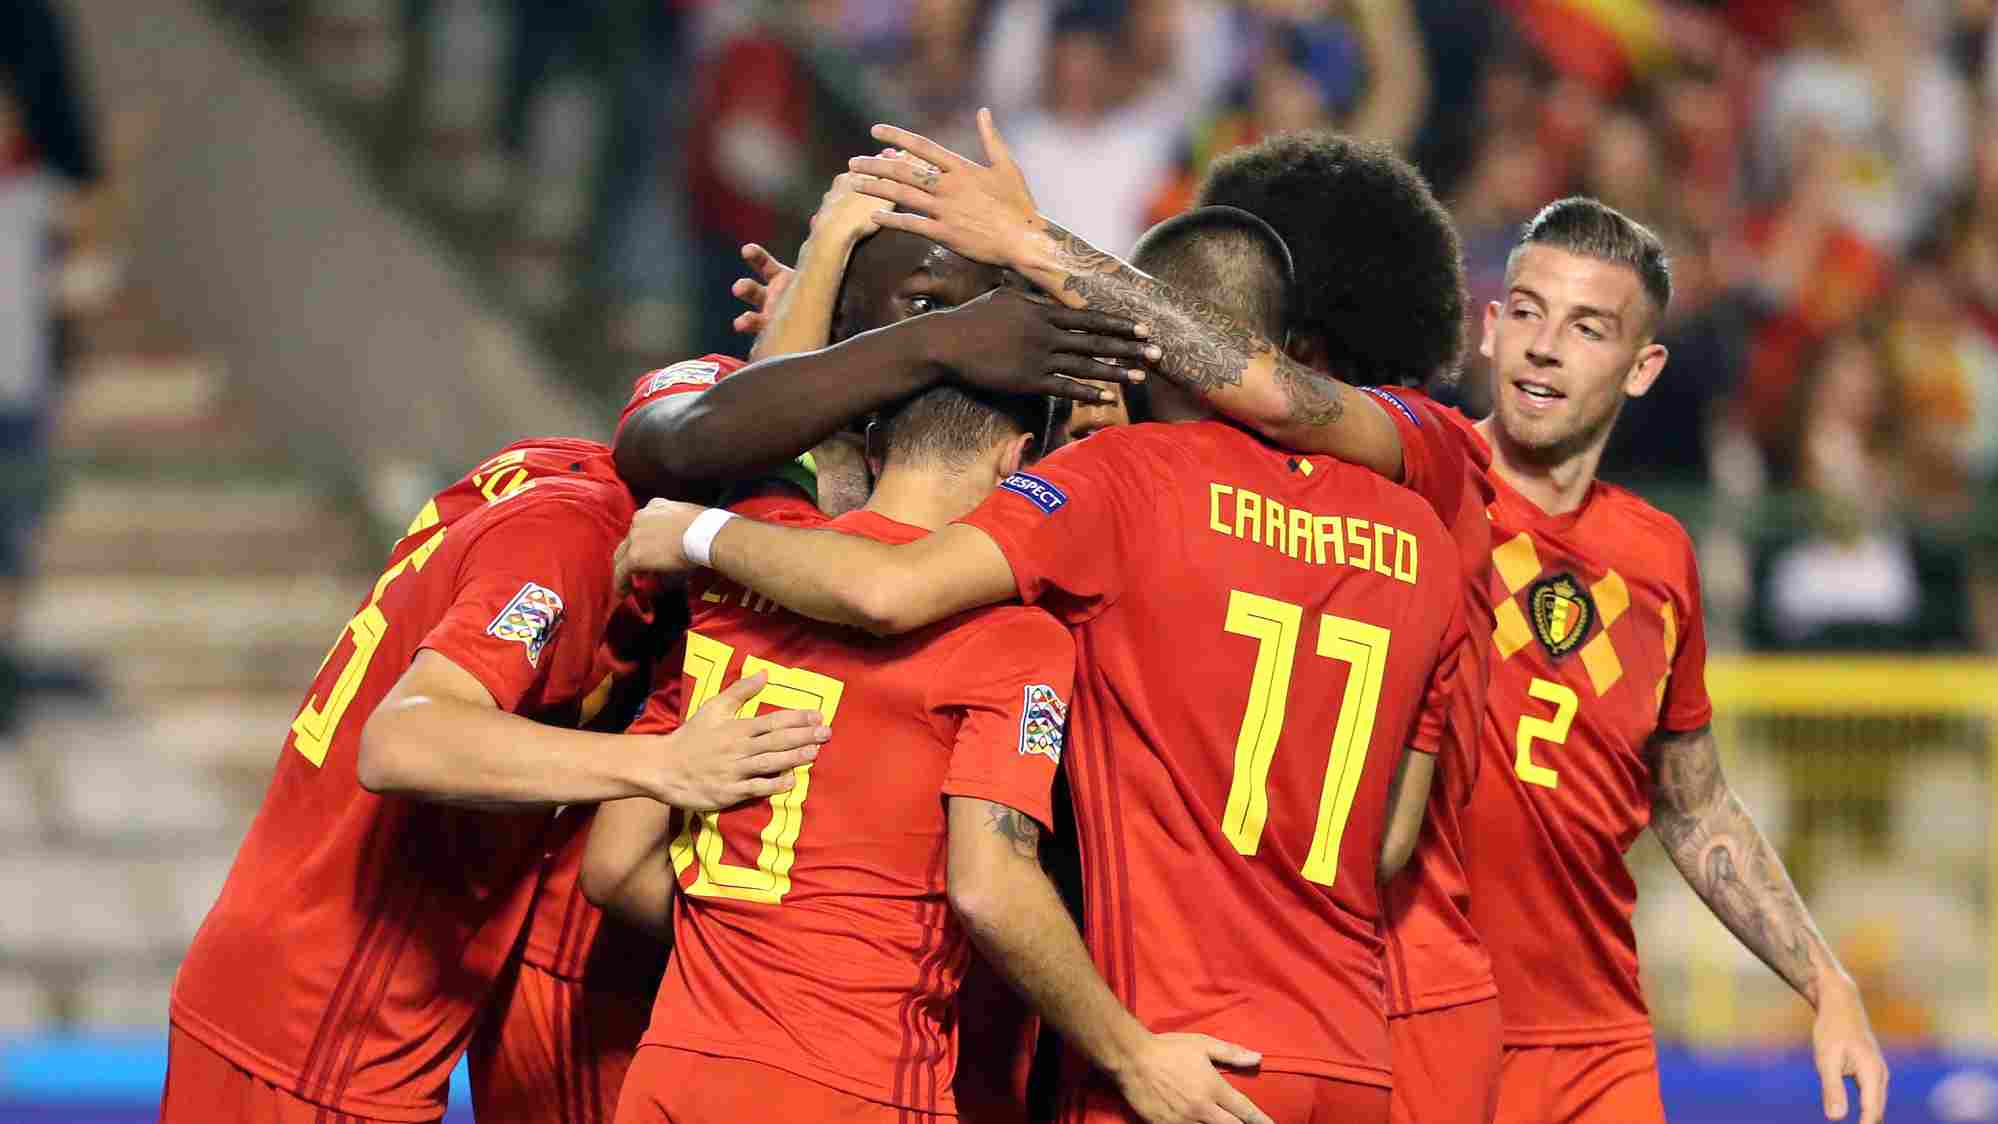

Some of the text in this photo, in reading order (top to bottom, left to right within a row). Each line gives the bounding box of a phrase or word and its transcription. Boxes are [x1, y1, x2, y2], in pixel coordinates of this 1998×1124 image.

[1209, 482, 1418, 585] CARRASCO
[1221, 588, 1391, 888] 11
[1514, 676, 1579, 790] 2
